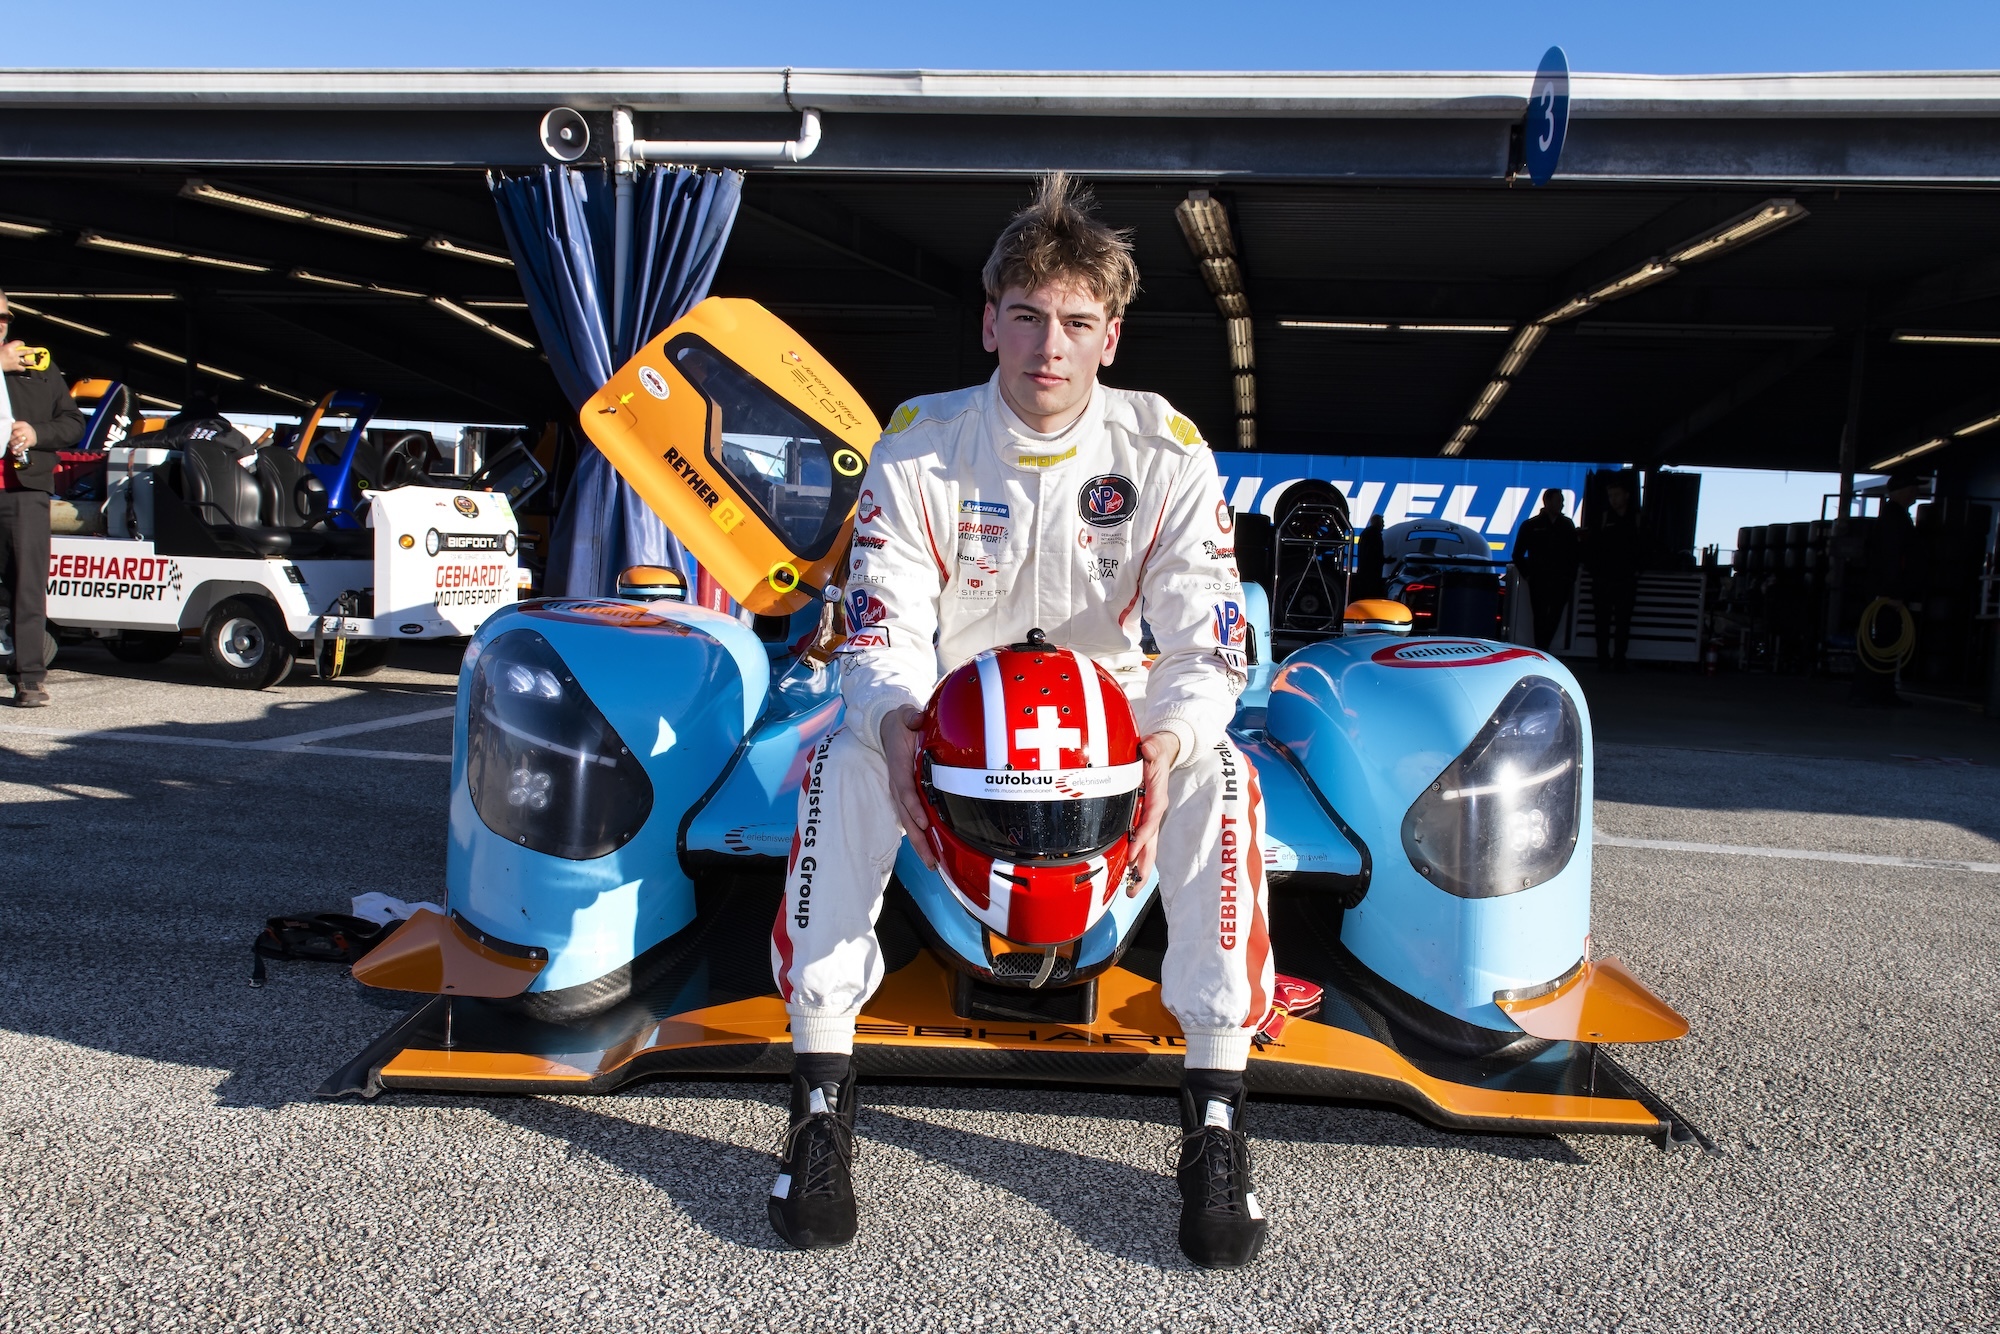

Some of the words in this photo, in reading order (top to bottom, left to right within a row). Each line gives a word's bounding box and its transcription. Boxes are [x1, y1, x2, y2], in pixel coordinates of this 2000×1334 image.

[1539, 81, 1554, 152] 3
[781, 353, 852, 430] VELOM
[801, 364, 835, 397] Jeremy
[835, 400, 862, 425] Siffert
[663, 446, 719, 509] REYHER
[49, 555, 169, 582] GEBHARDT
[436, 565, 503, 587] GEBHARDT
[1087, 557, 1119, 573] SUPER
[1088, 568, 1116, 582] NOVA
[46, 580, 167, 602] MOTORSPORT
[433, 589, 503, 607] MOTORSPORT
[985, 772, 1053, 785] autobau
[795, 856, 817, 930] Group
[1221, 814, 1237, 951] GEBHARDT
